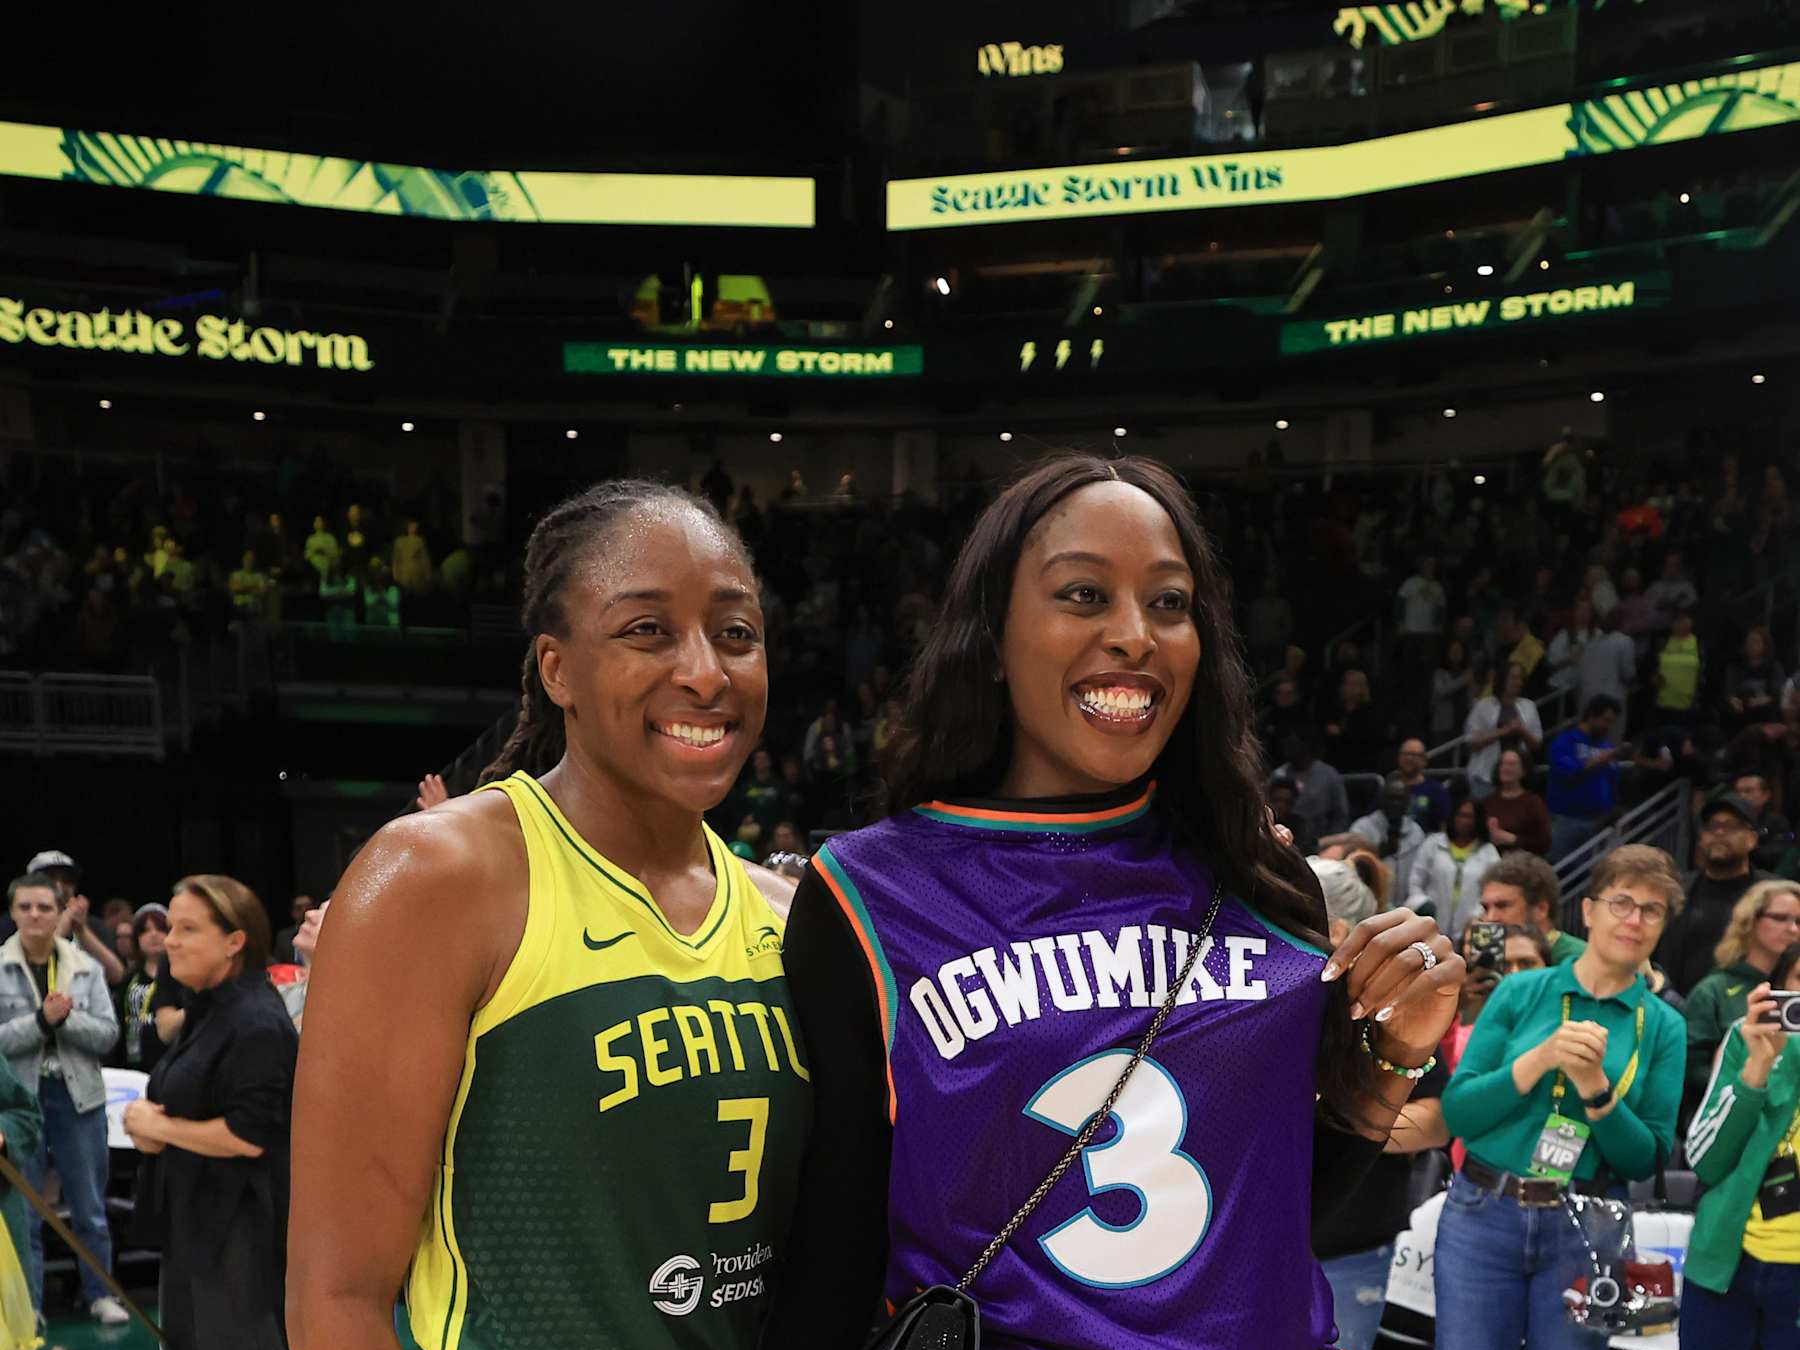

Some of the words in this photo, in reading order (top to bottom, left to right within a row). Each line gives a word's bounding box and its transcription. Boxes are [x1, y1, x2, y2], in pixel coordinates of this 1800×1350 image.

[977, 41, 1064, 77] Wins
[930, 182, 1050, 214] Seattle
[1063, 174, 1179, 204] Storm
[1191, 163, 1282, 193] Wins
[0, 297, 190, 355] Seattle
[196, 314, 375, 372] Storm
[1324, 314, 1395, 344] THE
[1402, 300, 1491, 334] NEW
[1499, 281, 1635, 321] STORM
[607, 348, 678, 371] THE
[685, 349, 767, 372] NEW
[775, 351, 894, 374] STORM
[909, 924, 1267, 1060] OGWUMIKE
[707, 1097, 770, 1224] 3
[1022, 1047, 1213, 1290] 3
[1540, 1141, 1574, 1168] VIP
